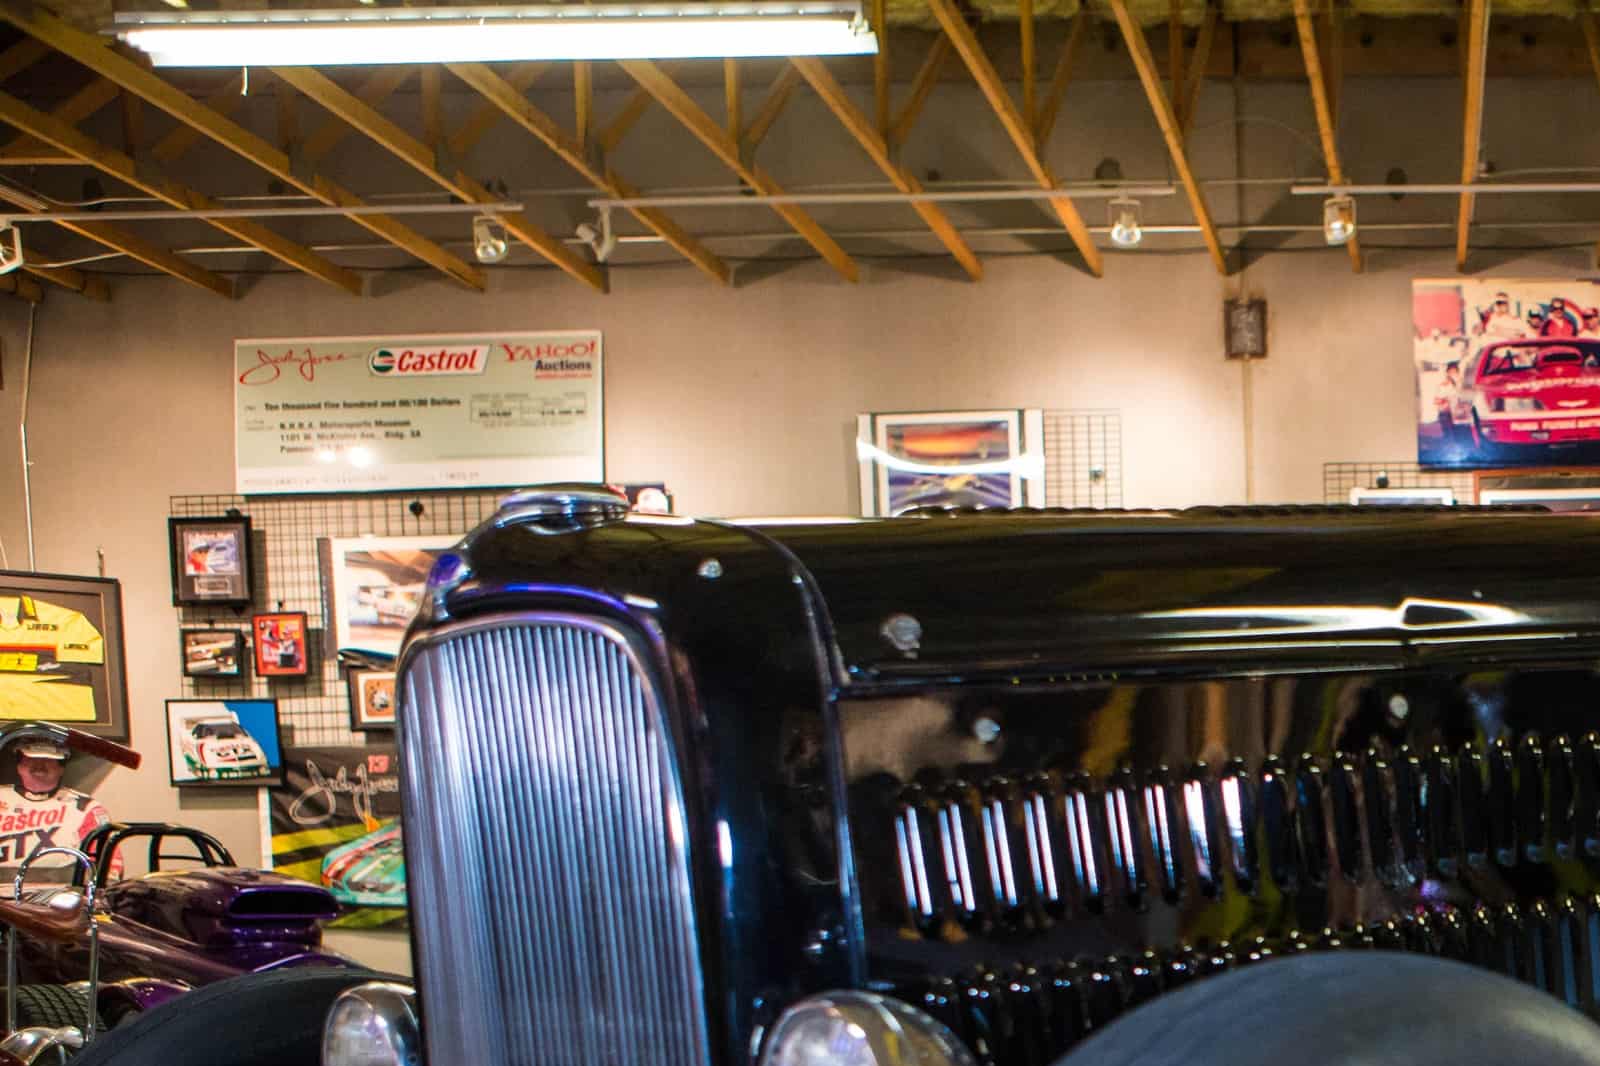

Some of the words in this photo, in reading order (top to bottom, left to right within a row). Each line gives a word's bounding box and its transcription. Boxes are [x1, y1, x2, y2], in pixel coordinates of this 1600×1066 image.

[398, 349, 478, 373] Castrol
[502, 341, 595, 363] YAHOO!
[535, 360, 592, 371] Auctions
[0, 805, 67, 833] astrol
